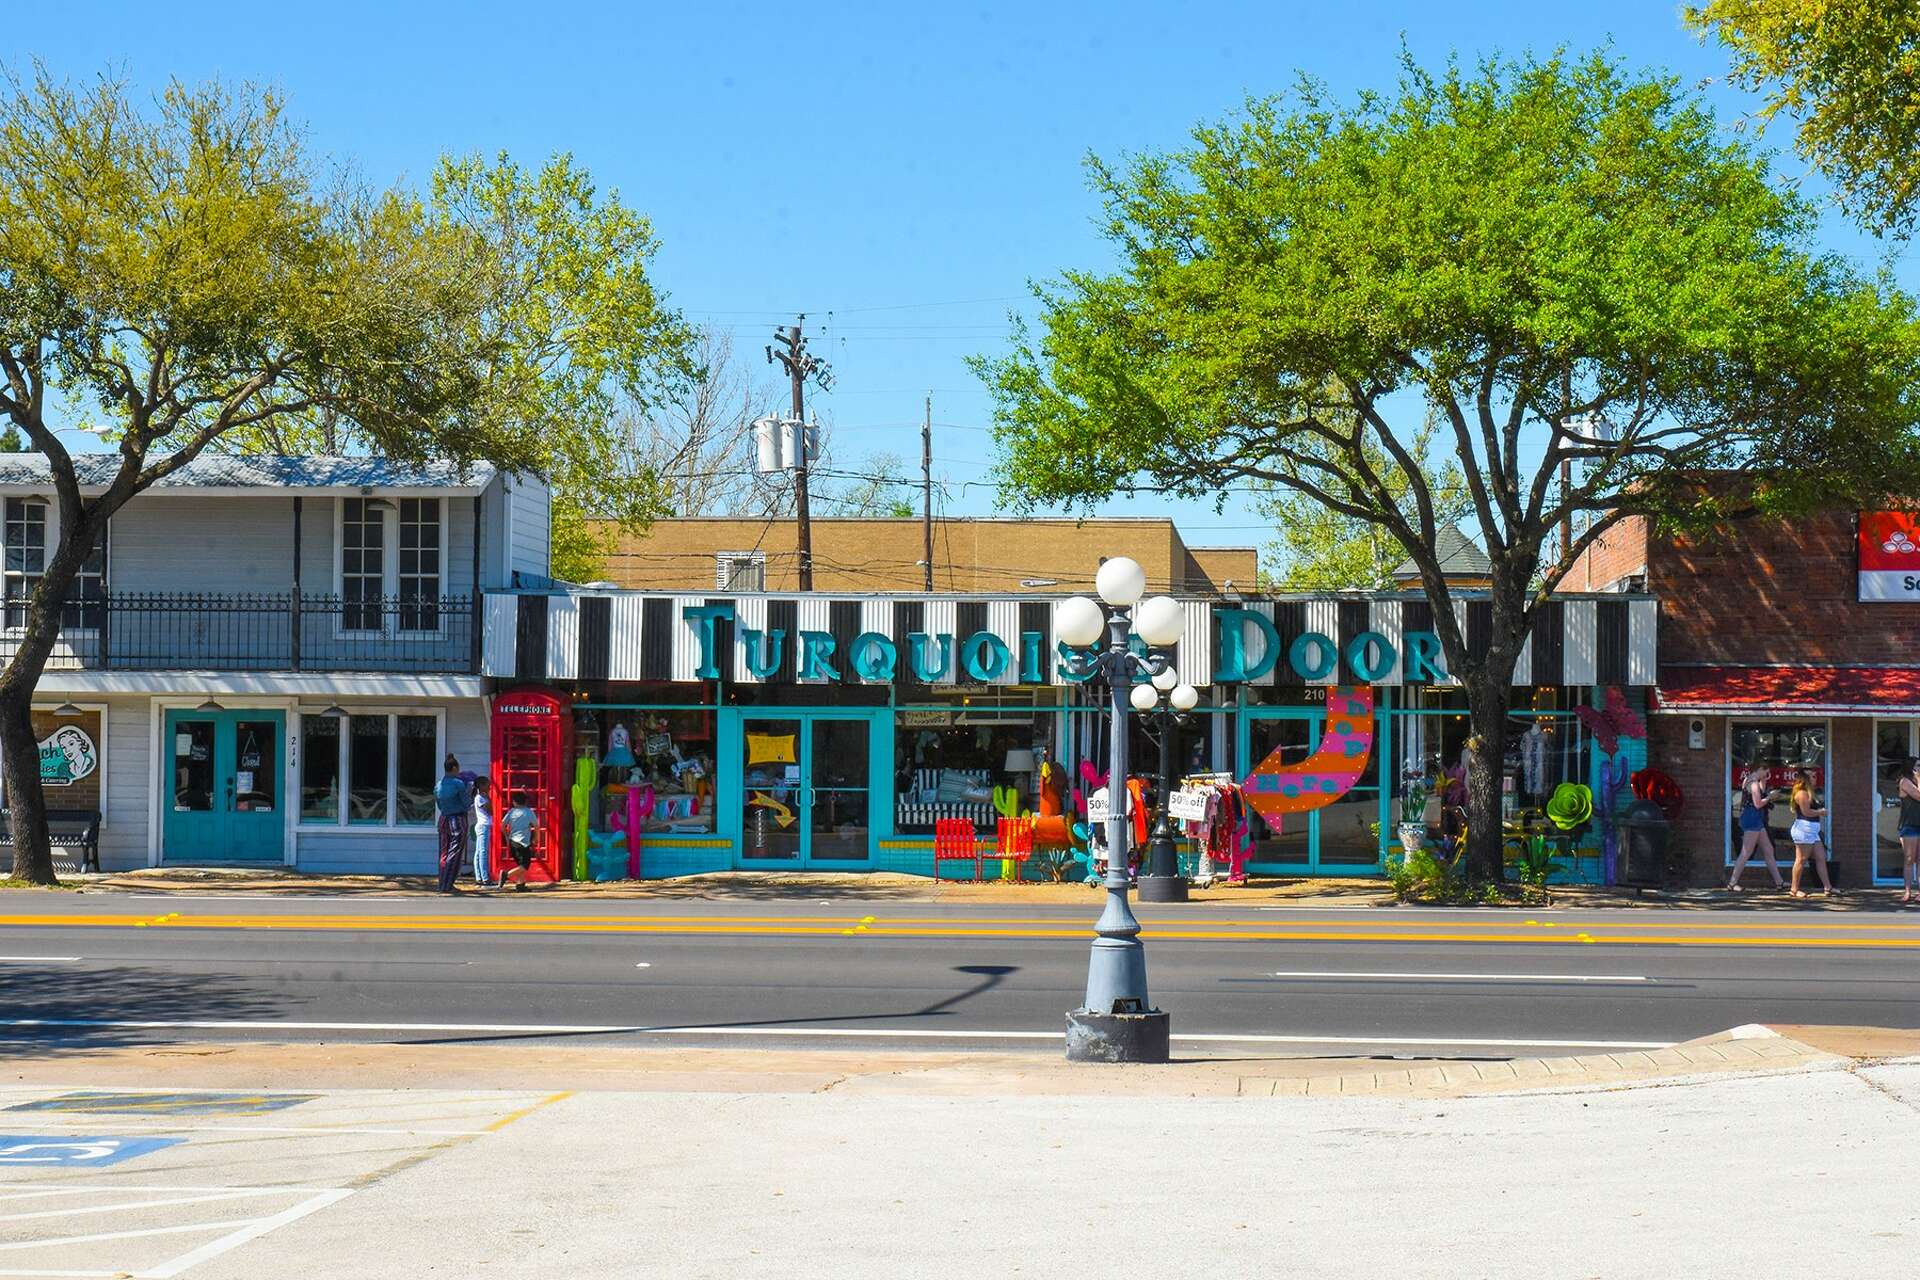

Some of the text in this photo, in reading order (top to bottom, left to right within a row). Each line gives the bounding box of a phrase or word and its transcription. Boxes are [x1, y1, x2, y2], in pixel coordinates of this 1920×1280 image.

[1212, 608, 1448, 684] DOOR
[1304, 689, 1325, 700] 210
[500, 704, 551, 714] TELEPHONE
[41, 741, 61, 760] ch
[1256, 773, 1337, 798] Here
[1089, 799, 1109, 810] 50%
[1171, 794, 1204, 808] 50% off
